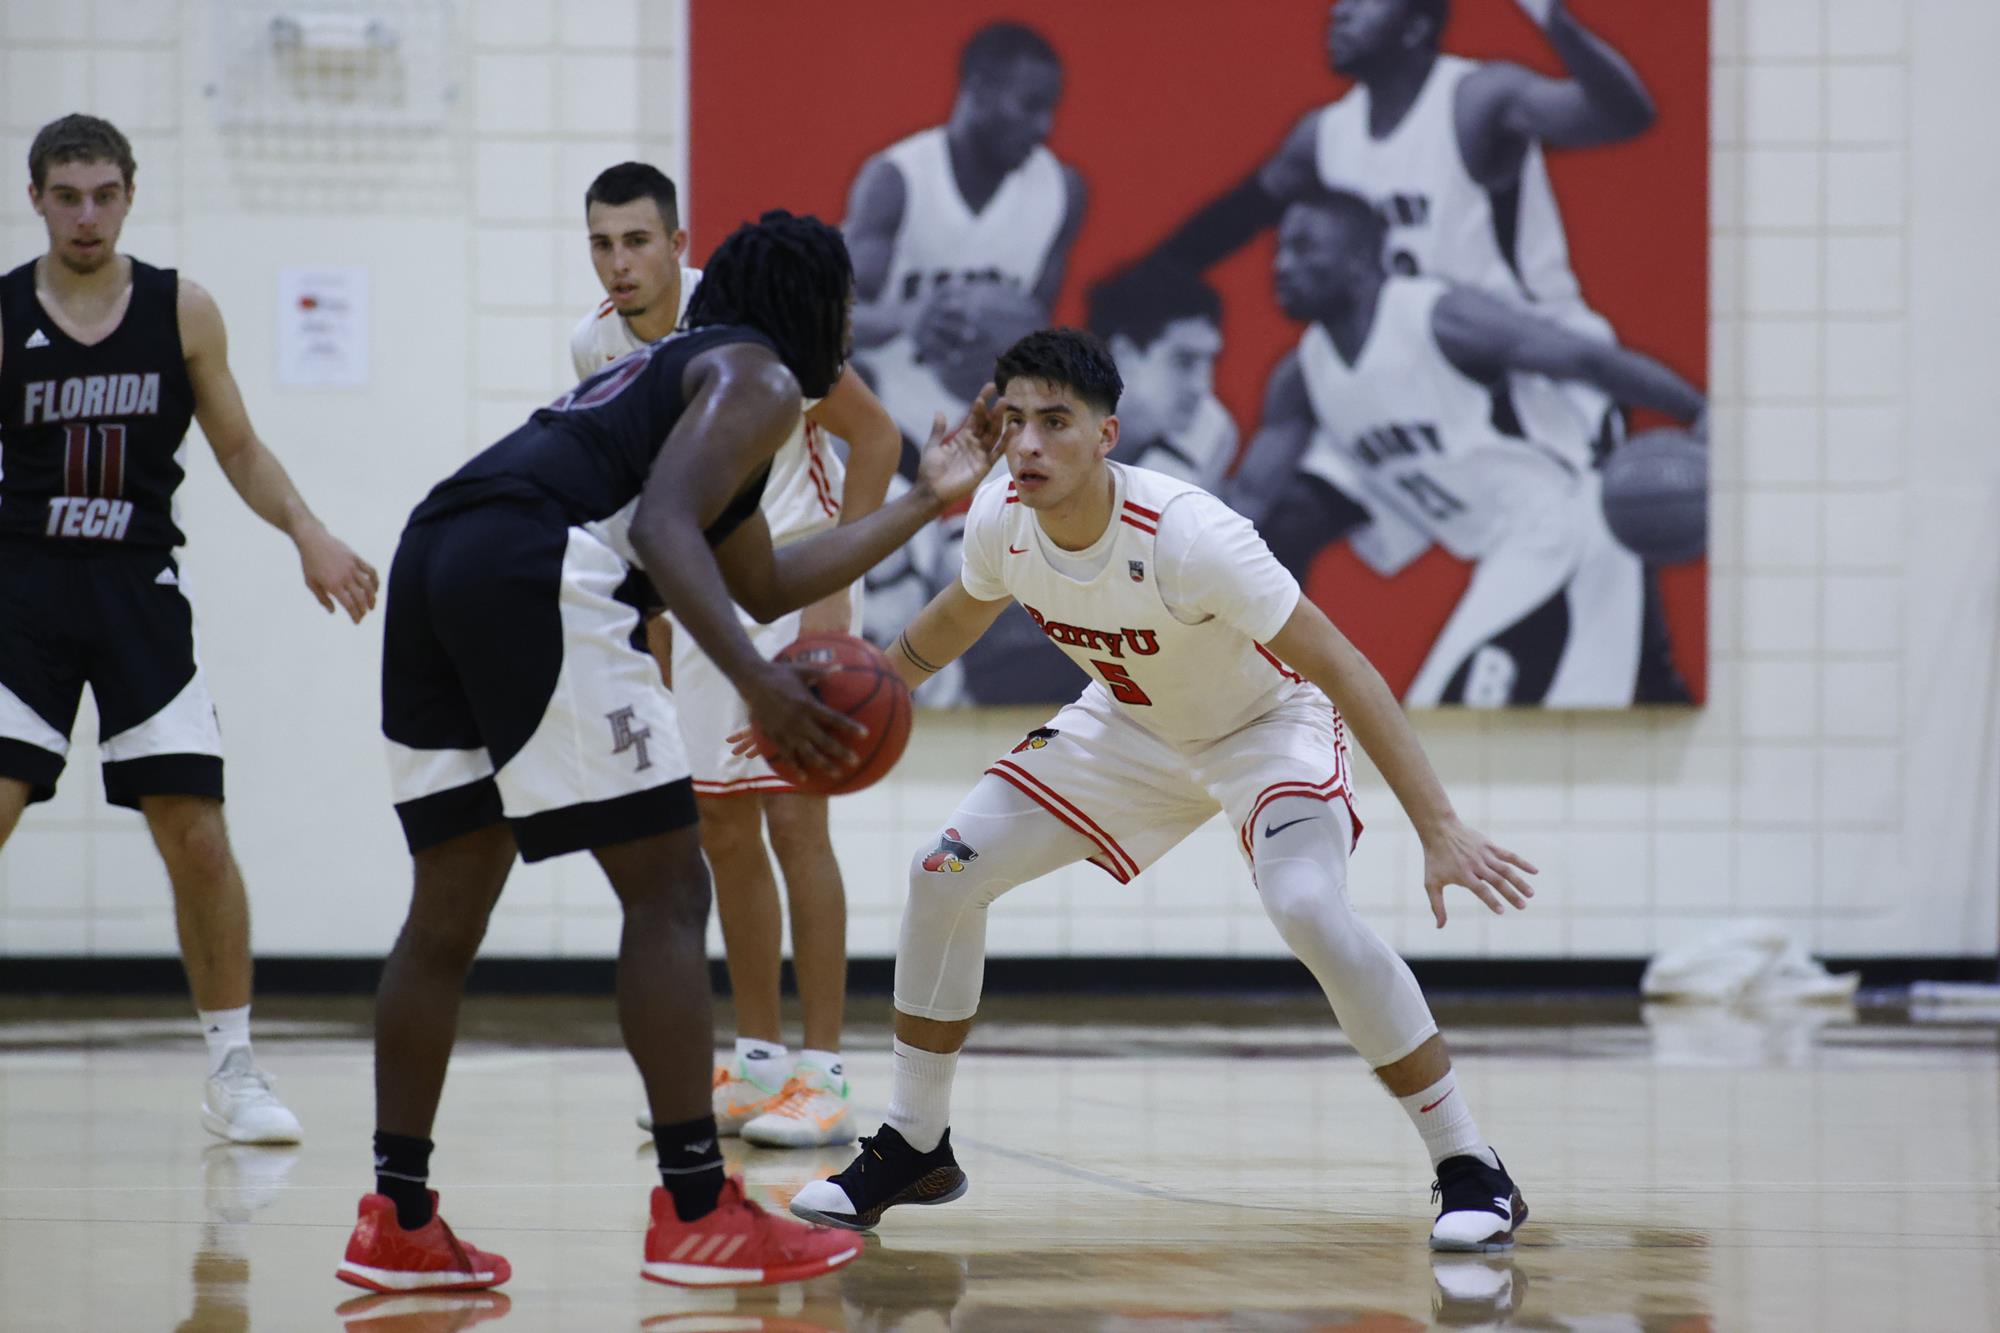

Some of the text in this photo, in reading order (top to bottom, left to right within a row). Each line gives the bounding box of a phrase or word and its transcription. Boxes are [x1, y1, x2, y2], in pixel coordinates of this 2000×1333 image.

[24, 372, 161, 425] FLORIDA
[62, 423, 126, 497] 11
[46, 496, 134, 541] TECH
[1089, 658, 1153, 707] 5
